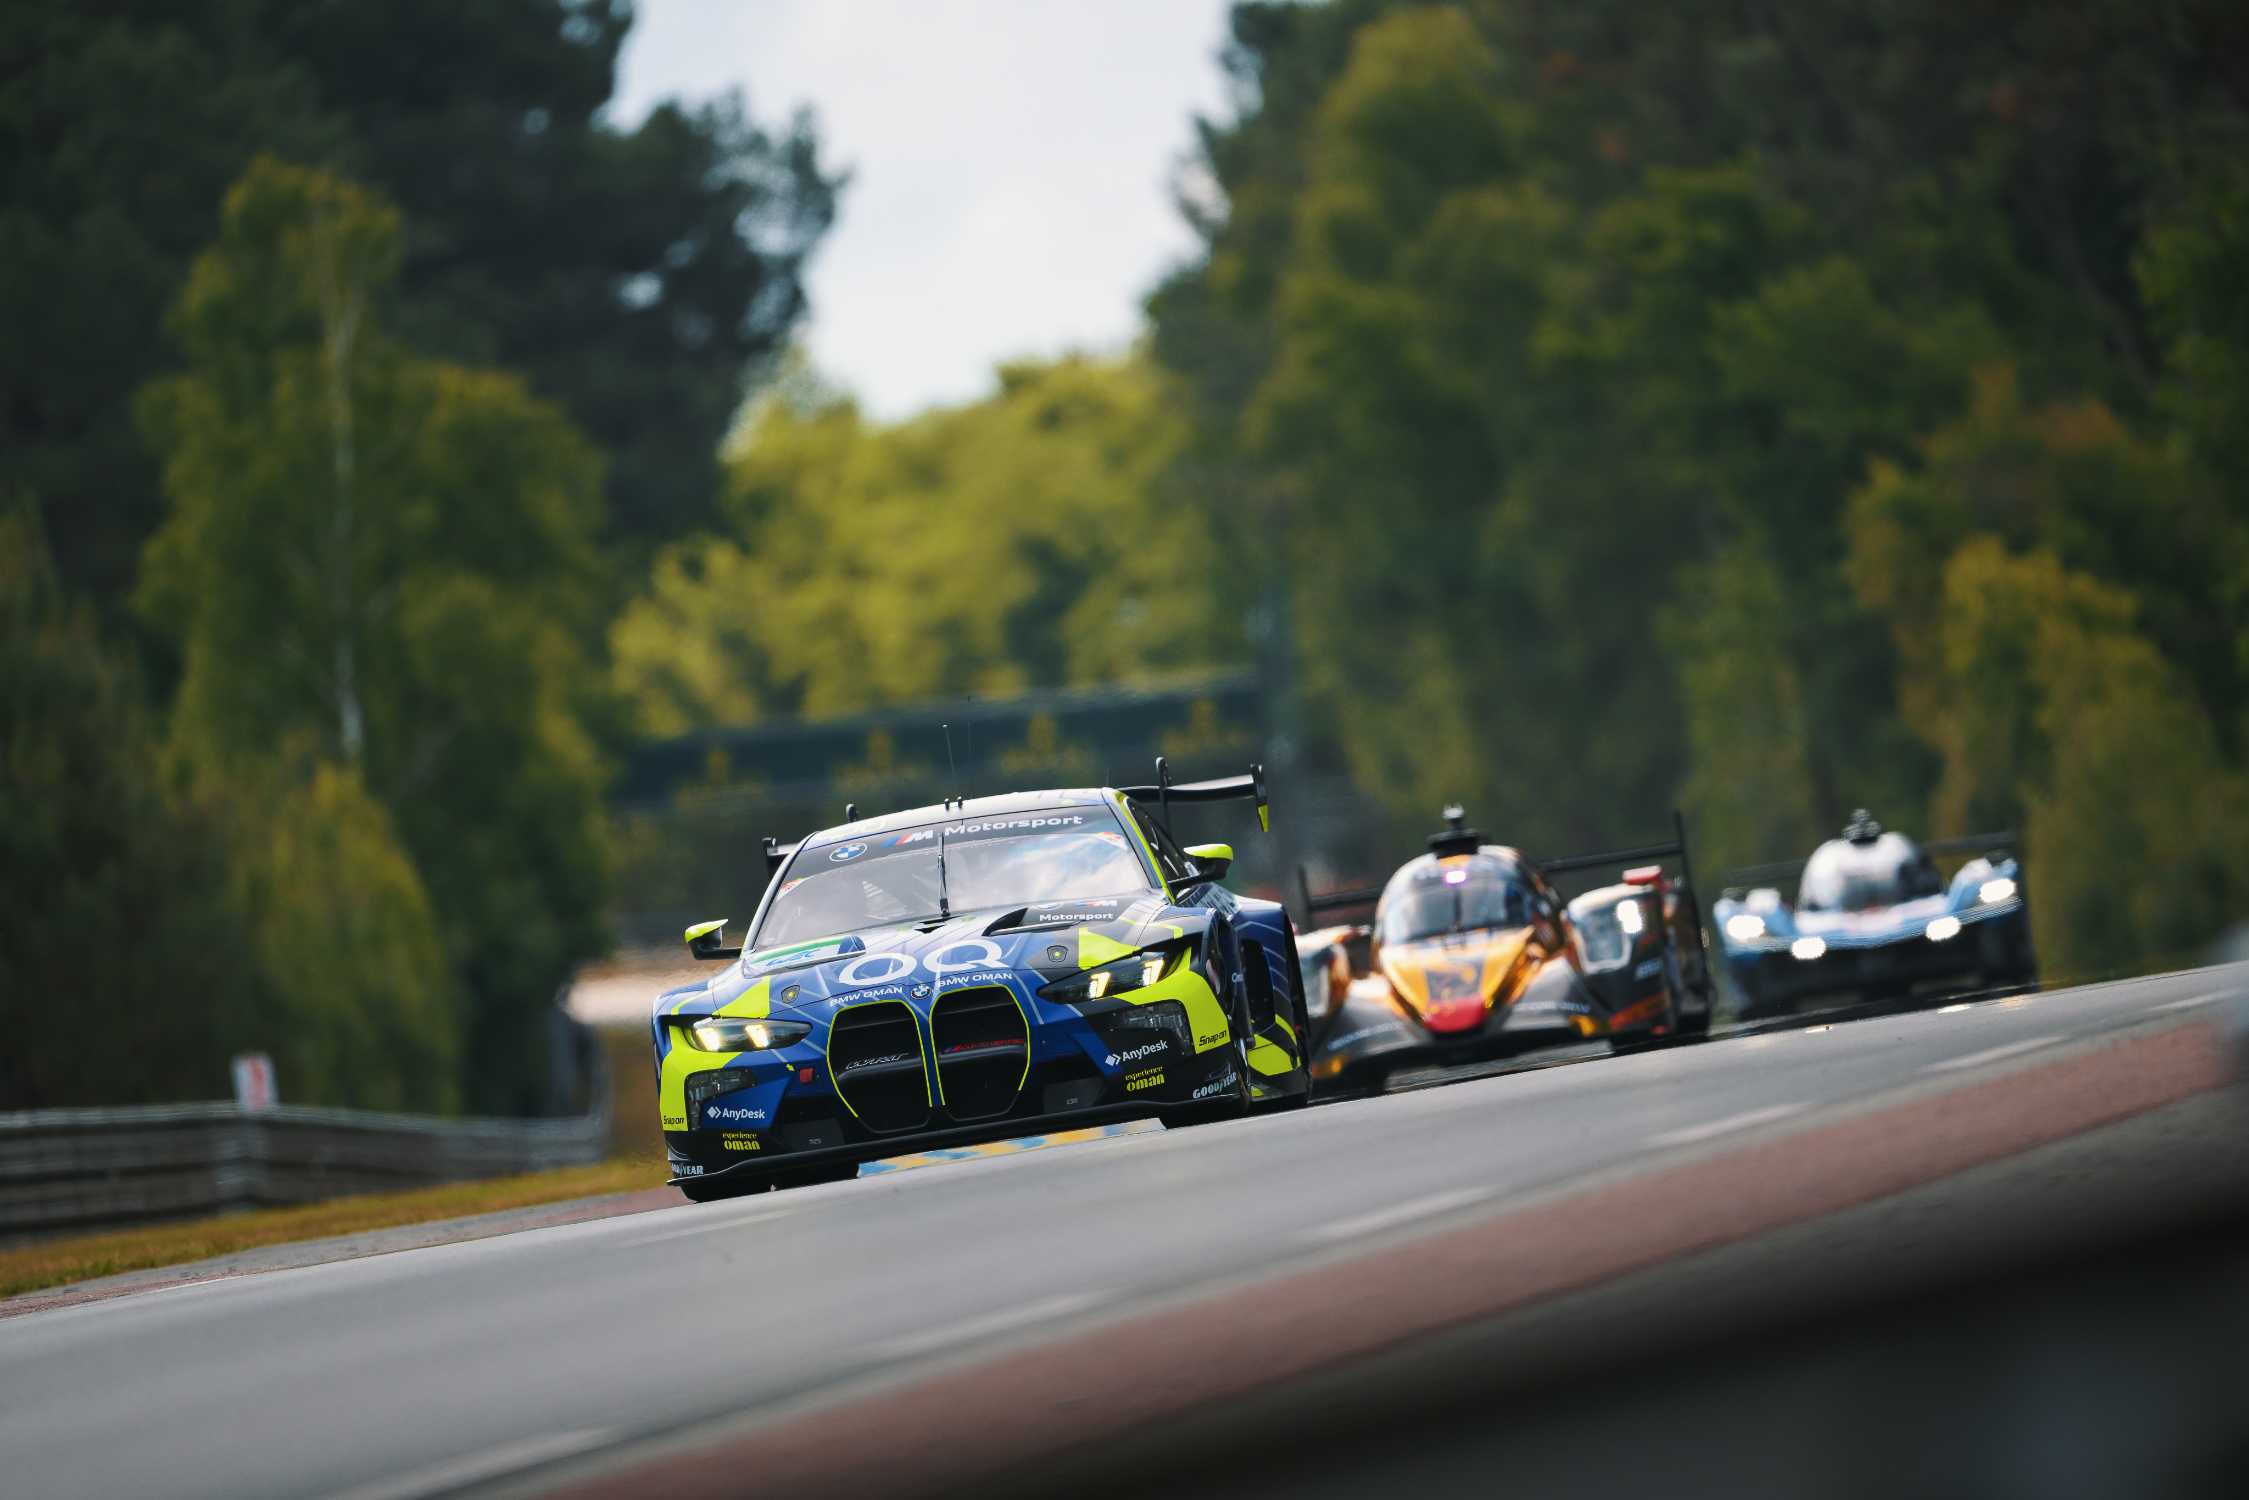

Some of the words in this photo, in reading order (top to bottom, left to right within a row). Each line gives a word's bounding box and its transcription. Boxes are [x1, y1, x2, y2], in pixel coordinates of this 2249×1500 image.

[944, 815, 1083, 836] Motorsport
[1039, 912, 1114, 921] Motorsport
[937, 975, 970, 988] BMW
[972, 971, 1013, 982] OMAN
[829, 992, 861, 1008] BMW
[863, 986, 903, 999] OMAN
[1122, 1039, 1169, 1062] AnyDesk
[1124, 1065, 1164, 1081] experience
[1126, 1073, 1165, 1092] oman
[1192, 1071, 1237, 1099] GOODYEAR
[722, 1107, 765, 1121] AnyDesk
[722, 1130, 757, 1140] experience
[723, 1140, 761, 1151] oman
